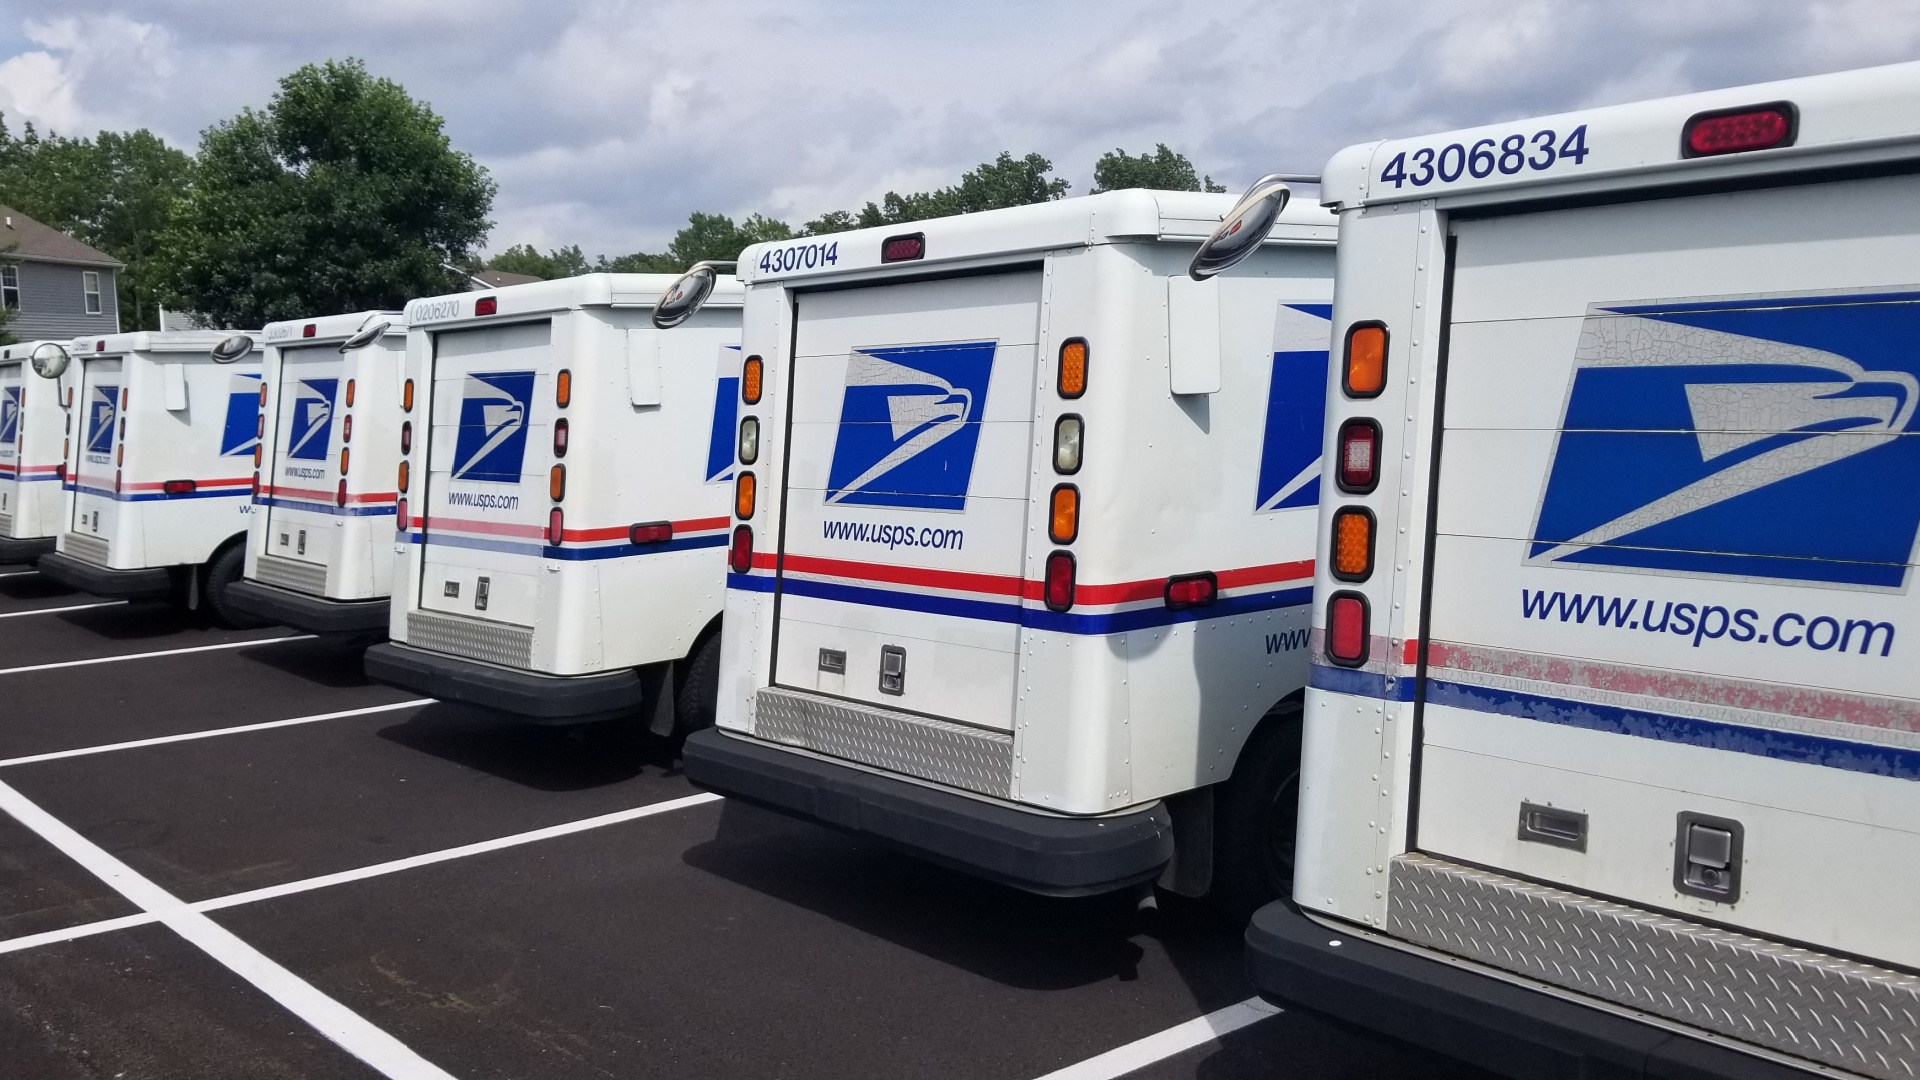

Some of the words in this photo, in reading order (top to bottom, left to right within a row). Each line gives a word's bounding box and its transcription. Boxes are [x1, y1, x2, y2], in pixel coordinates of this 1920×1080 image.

[1380, 124, 1590, 189] 4306834
[759, 241, 839, 274] 4307014
[448, 492, 519, 512] www.usps.com
[823, 520, 964, 551] www.usps.com
[1521, 588, 1895, 657] www.usps.com
